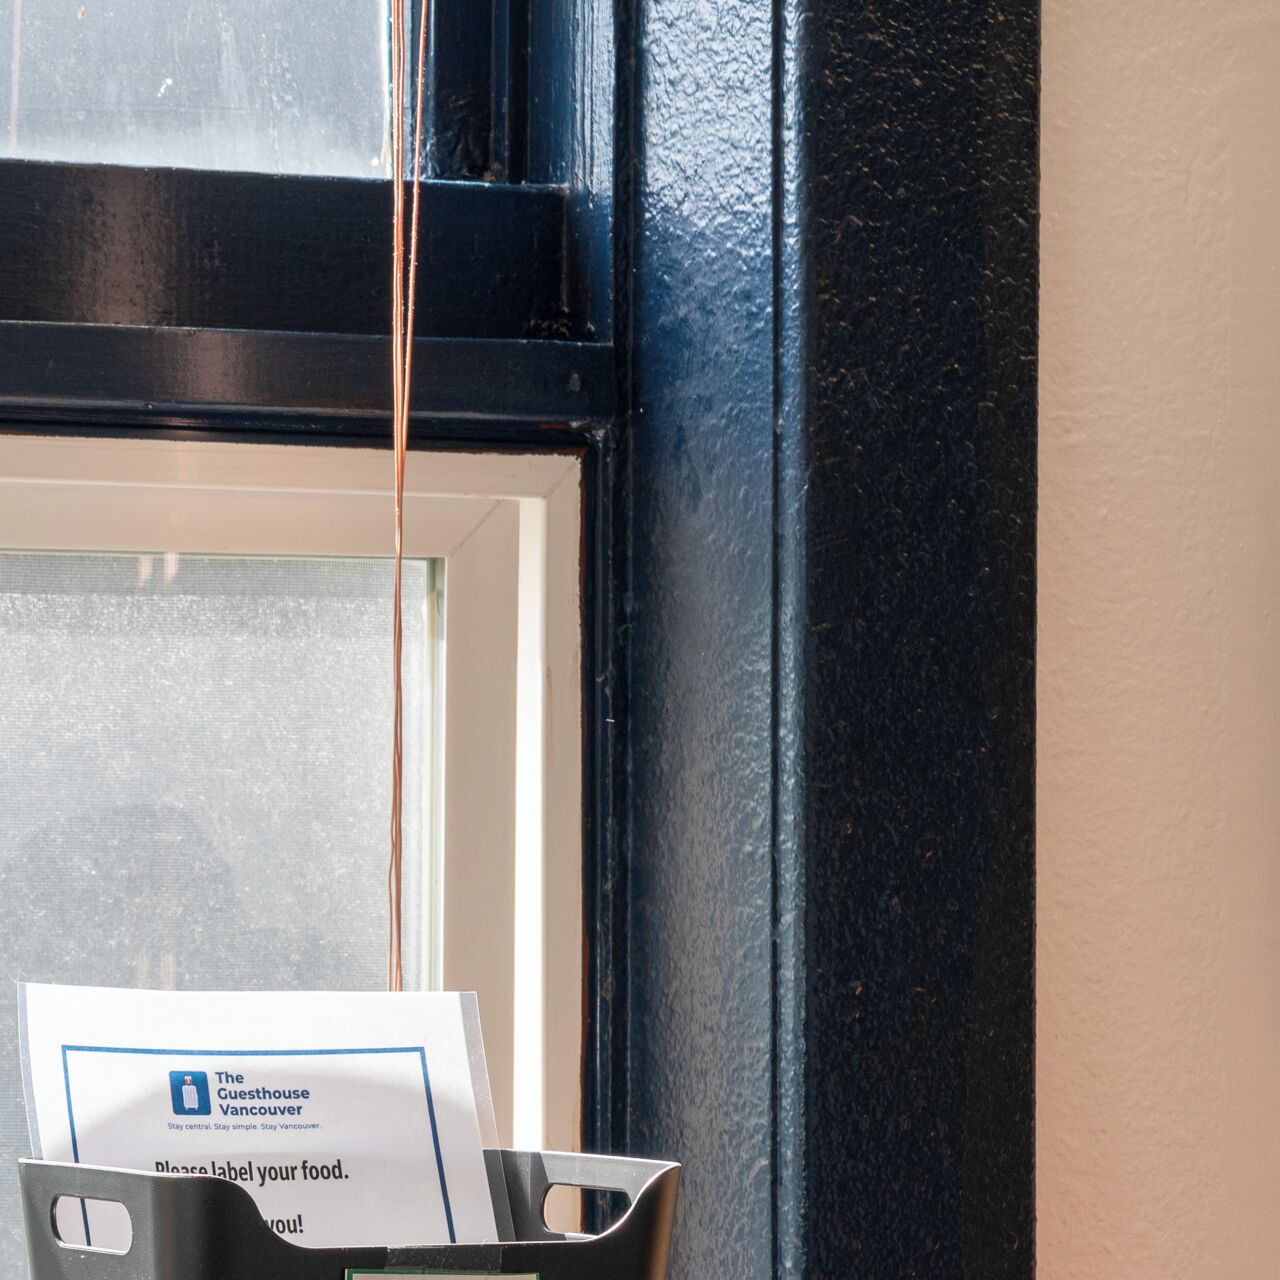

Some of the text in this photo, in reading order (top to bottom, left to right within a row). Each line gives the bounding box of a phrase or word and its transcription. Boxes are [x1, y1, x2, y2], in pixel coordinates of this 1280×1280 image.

[215, 1072, 244, 1084] The
[217, 1088, 310, 1100] Guesthouse
[219, 1104, 302, 1116] Vancouver
[212, 1161, 253, 1181] label
[257, 1165, 297, 1187] your
[302, 1160, 349, 1180] food.
